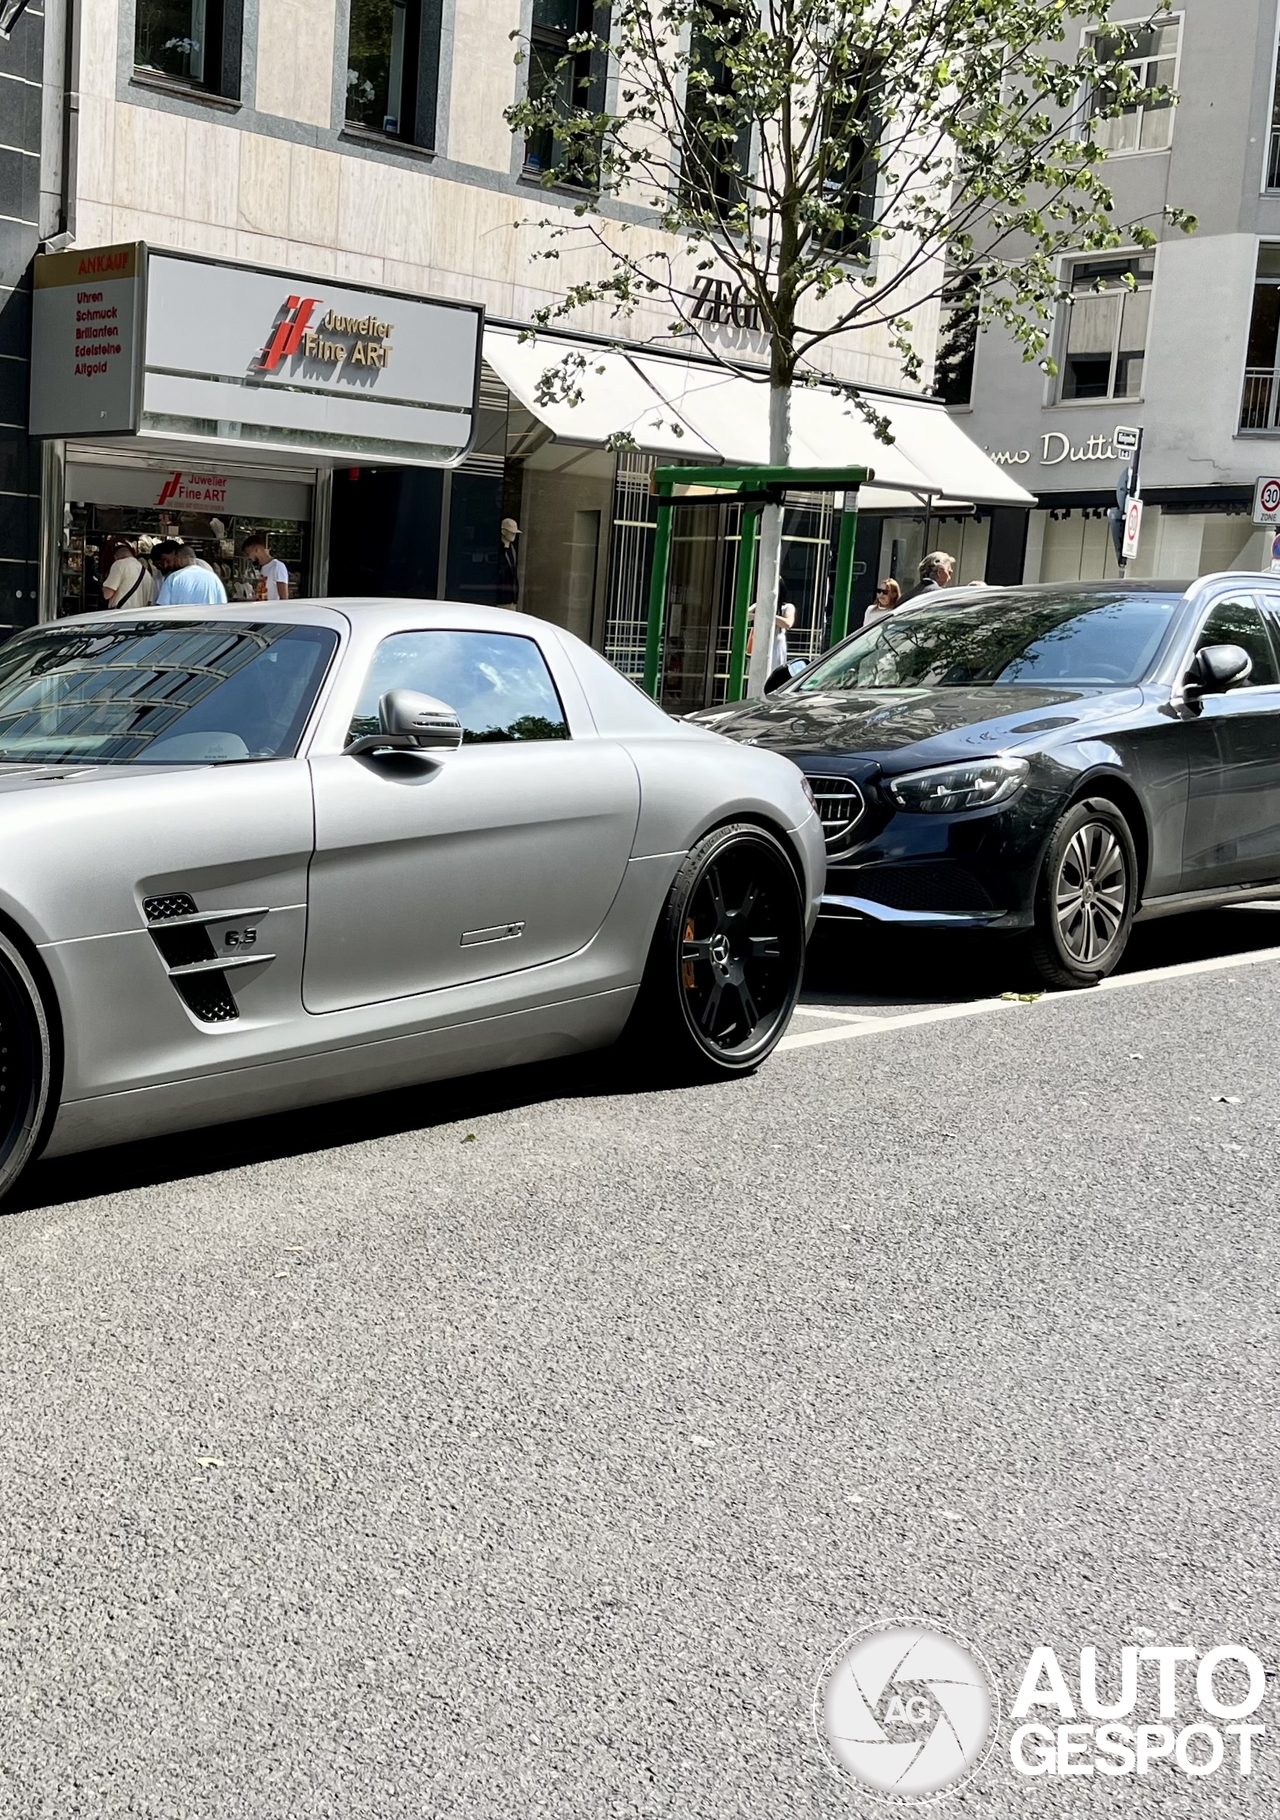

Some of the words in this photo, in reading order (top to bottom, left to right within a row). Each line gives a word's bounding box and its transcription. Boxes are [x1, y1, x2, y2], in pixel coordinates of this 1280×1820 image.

[78, 251, 129, 275] ANKAUF
[76, 291, 103, 304] Uhren
[691, 275, 778, 334] ZEGN
[76, 307, 118, 322] Schmuck
[324, 309, 394, 339] Juwelier
[75, 325, 119, 340] Brillanten
[75, 343, 122, 358] Edelsteine
[304, 332, 347, 362] Fine
[351, 340, 393, 369] ART
[74, 361, 108, 377] Altgold
[1039, 431, 1118, 465] Dutti
[188, 474, 227, 487] Juwelier
[178, 486, 202, 500] Fine
[203, 489, 227, 502] ART
[1265, 488, 1279, 504] 30
[1260, 513, 1277, 522] ZONE
[225, 927, 257, 946] 6.3
